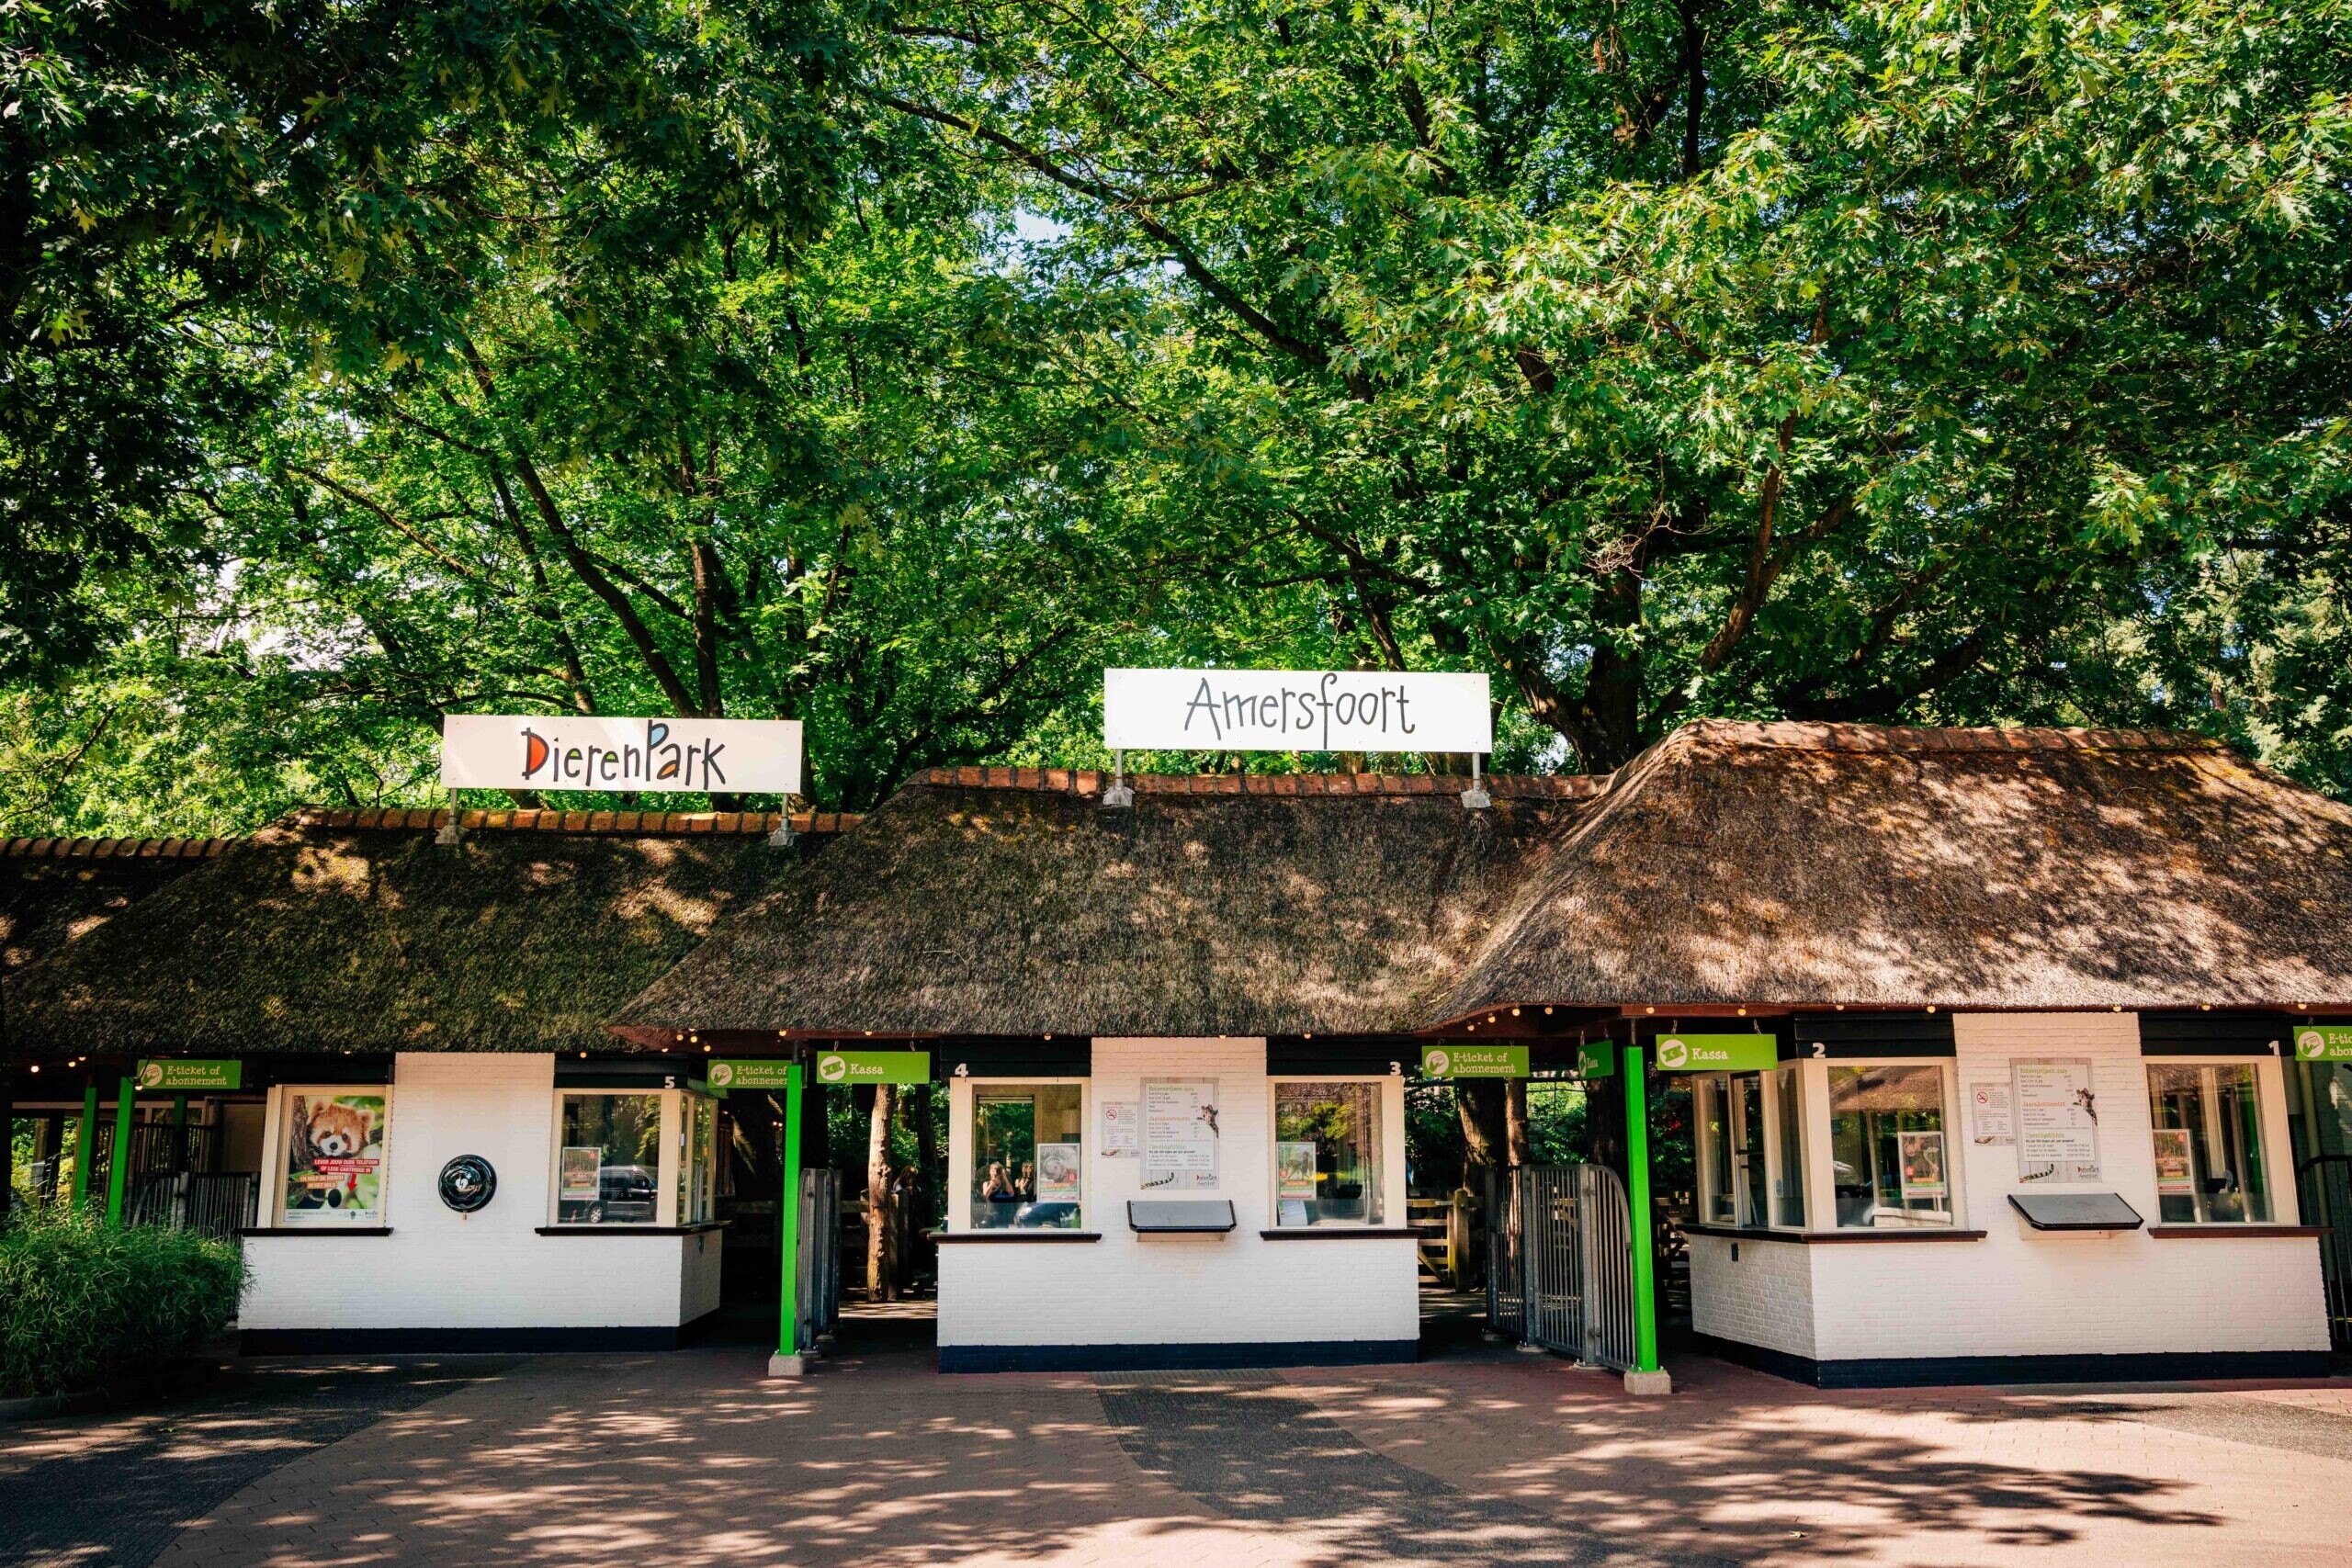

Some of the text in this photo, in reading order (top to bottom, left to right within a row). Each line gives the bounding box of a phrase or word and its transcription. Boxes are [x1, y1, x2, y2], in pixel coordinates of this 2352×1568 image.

[1184, 672, 1415, 750] Amersfoort
[521, 719, 726, 790] DierenPark
[1691, 1047, 1728, 1060] Kassa
[1812, 1042, 1826, 1058] 2
[2268, 1040, 2280, 1055] 1
[1453, 1052, 1508, 1063] E-ticket of
[167, 1066, 220, 1076] E-ticket of
[736, 1066, 787, 1076] E-ticket of
[850, 1063, 884, 1075] Kassa
[955, 1063, 968, 1077] 4
[1389, 1061, 1401, 1076] 3
[1453, 1064, 1516, 1074] abonnement
[165, 1076, 227, 1086] abonnement
[664, 1076, 675, 1089] 5
[736, 1077, 788, 1085] abonneme
